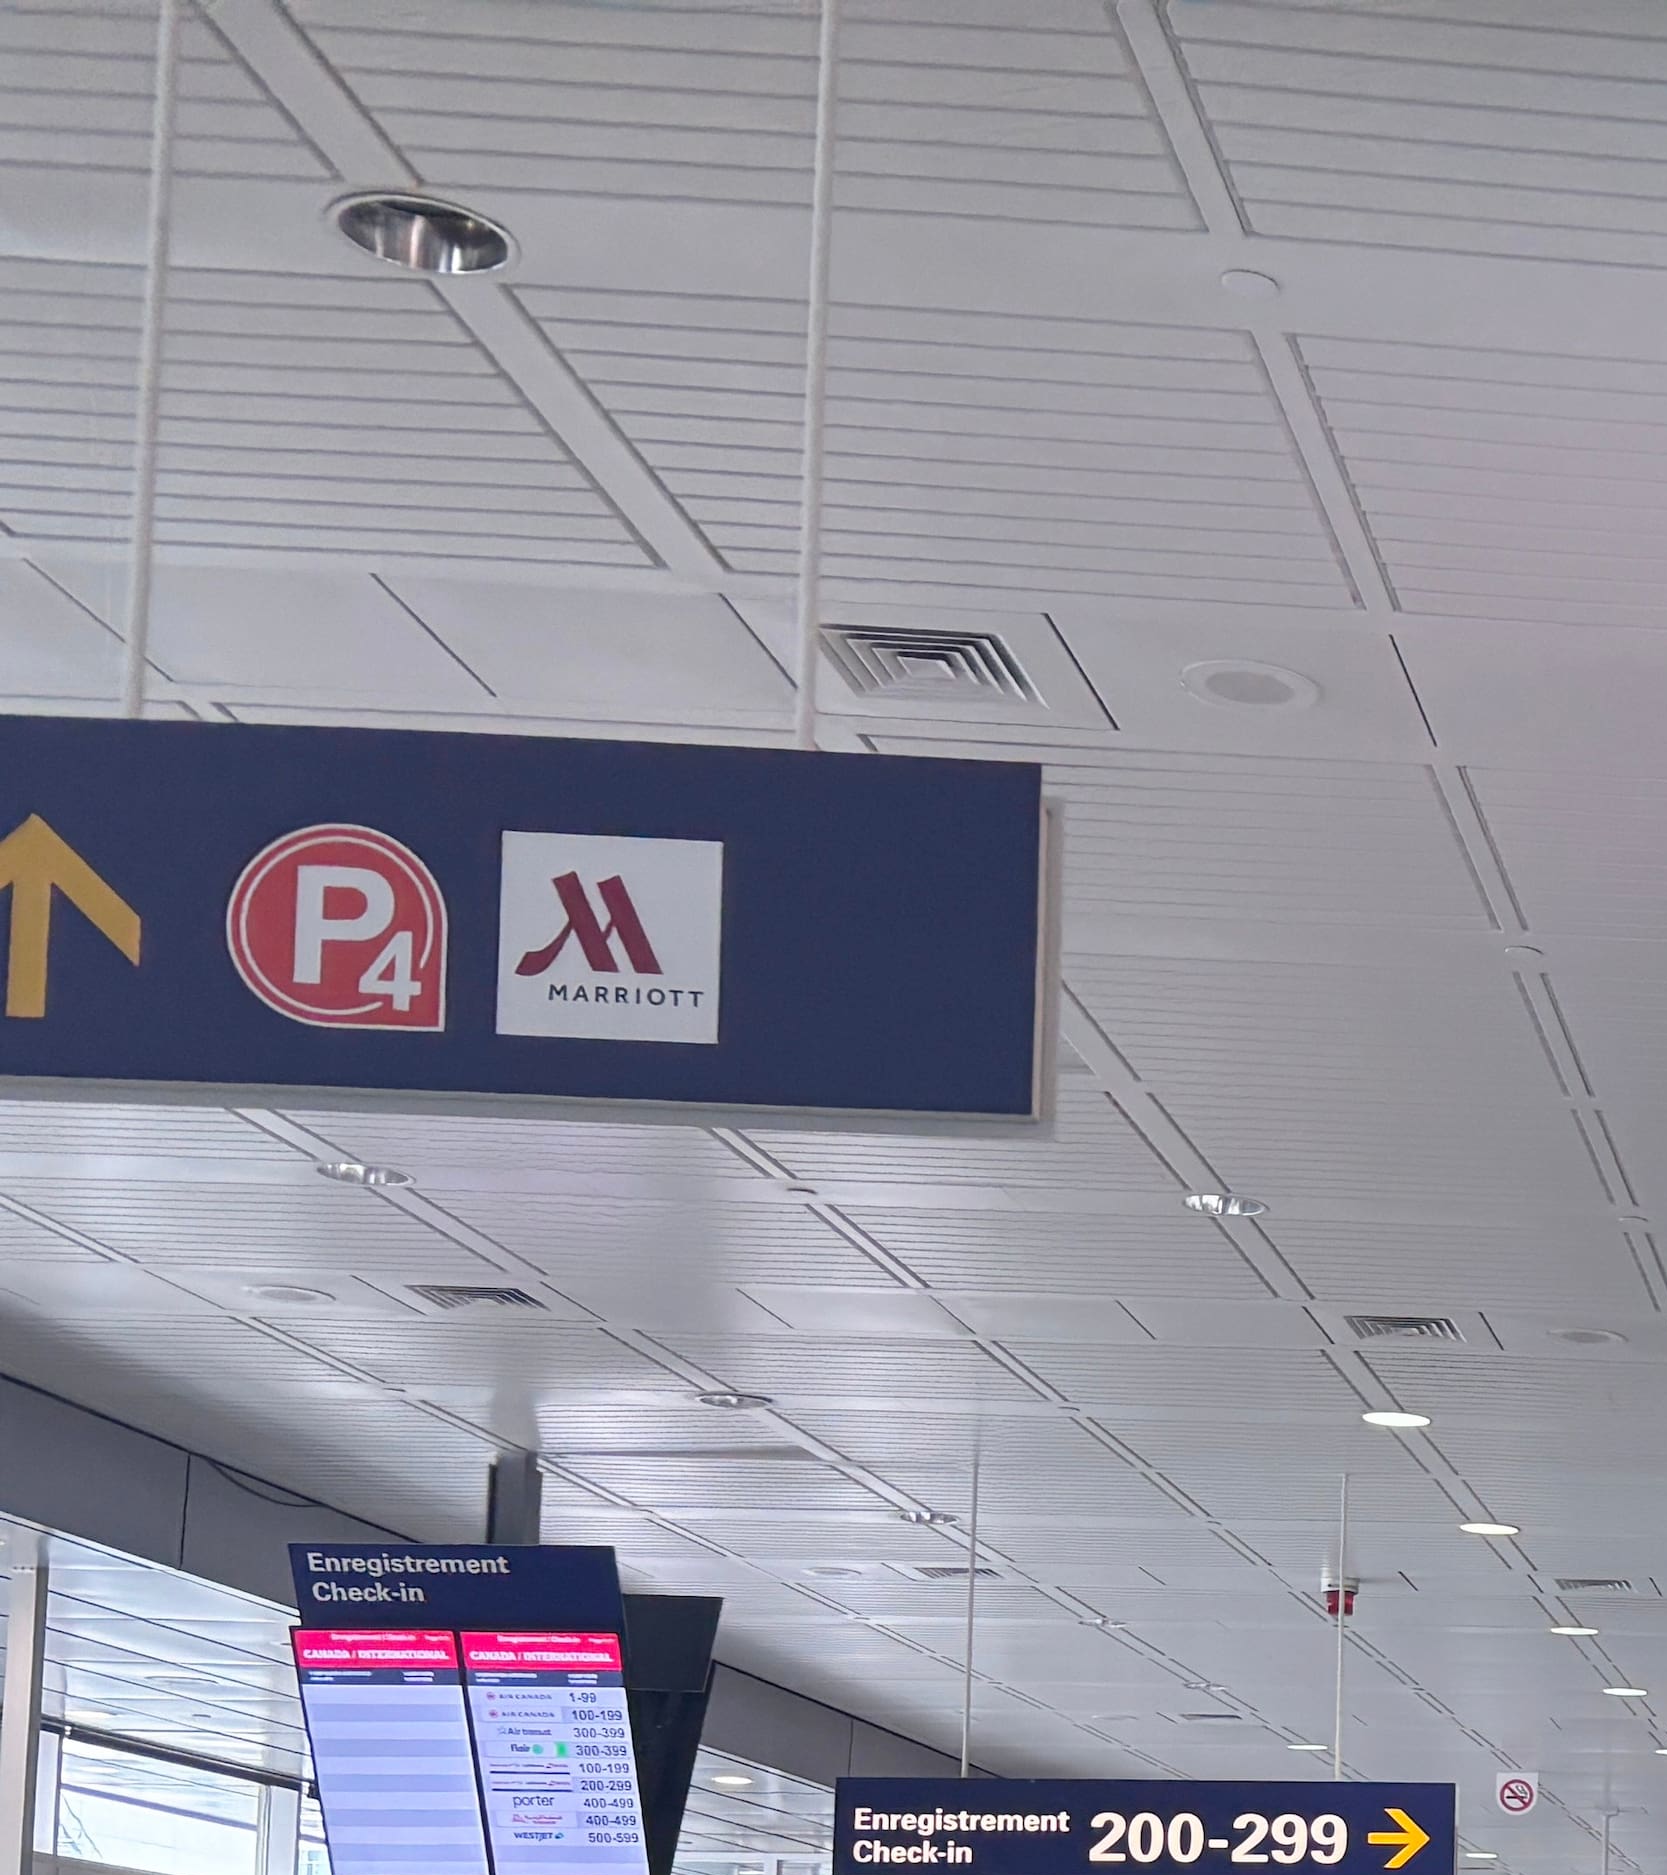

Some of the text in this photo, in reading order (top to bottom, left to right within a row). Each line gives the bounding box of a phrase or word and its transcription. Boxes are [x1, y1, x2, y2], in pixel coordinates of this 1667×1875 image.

[548, 984, 704, 1007] MARRIOTT
[307, 1553, 510, 1577] Enregistrement
[312, 1583, 425, 1603] Check-in
[853, 1808, 1347, 1864] Enregistrement 200-299
[852, 1840, 972, 1864] Check-in
